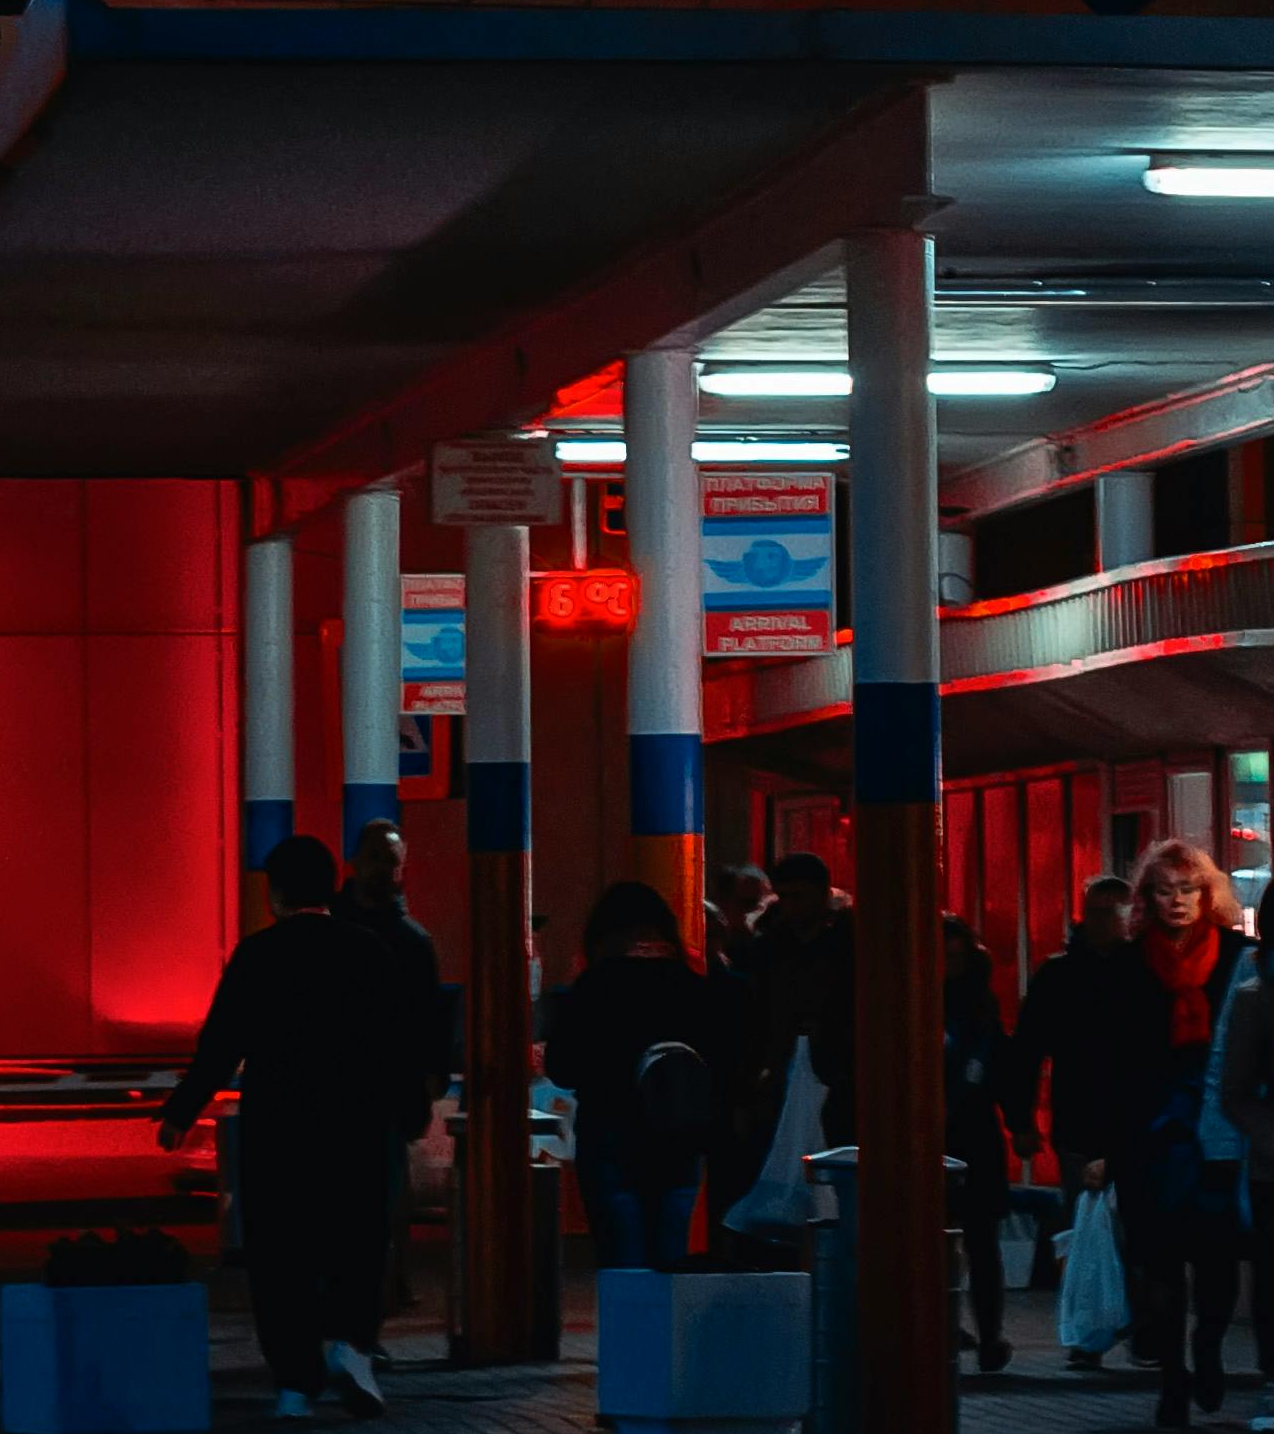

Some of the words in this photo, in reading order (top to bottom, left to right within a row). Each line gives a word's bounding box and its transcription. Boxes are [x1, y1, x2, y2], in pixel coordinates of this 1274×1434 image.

[705, 476, 826, 493] ПЛАТФОРМА
[711, 495, 820, 513] ПРИБЫТИЯ
[729, 615, 812, 632] ARRIVAL
[717, 634, 824, 652] PLATFORM
